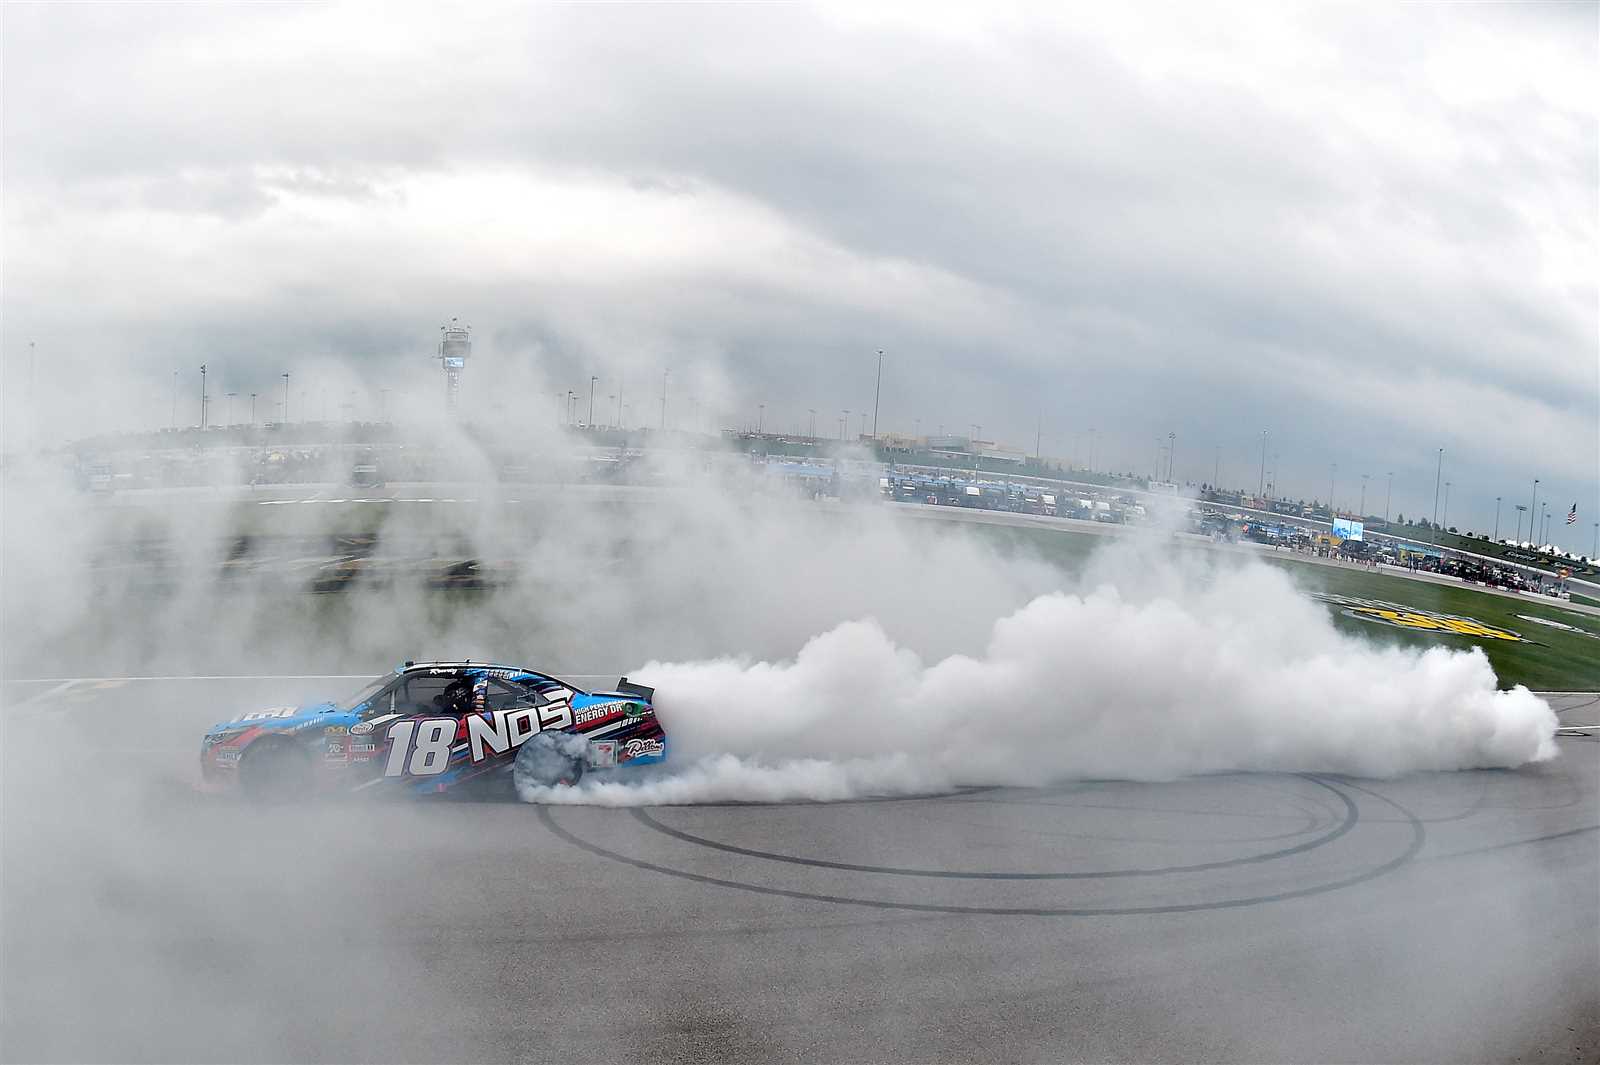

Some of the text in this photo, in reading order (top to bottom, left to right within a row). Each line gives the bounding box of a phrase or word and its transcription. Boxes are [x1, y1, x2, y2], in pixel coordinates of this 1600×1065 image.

[467, 687, 574, 763] NOS
[575, 706, 609, 725] ENERGY
[384, 717, 459, 777] 18
